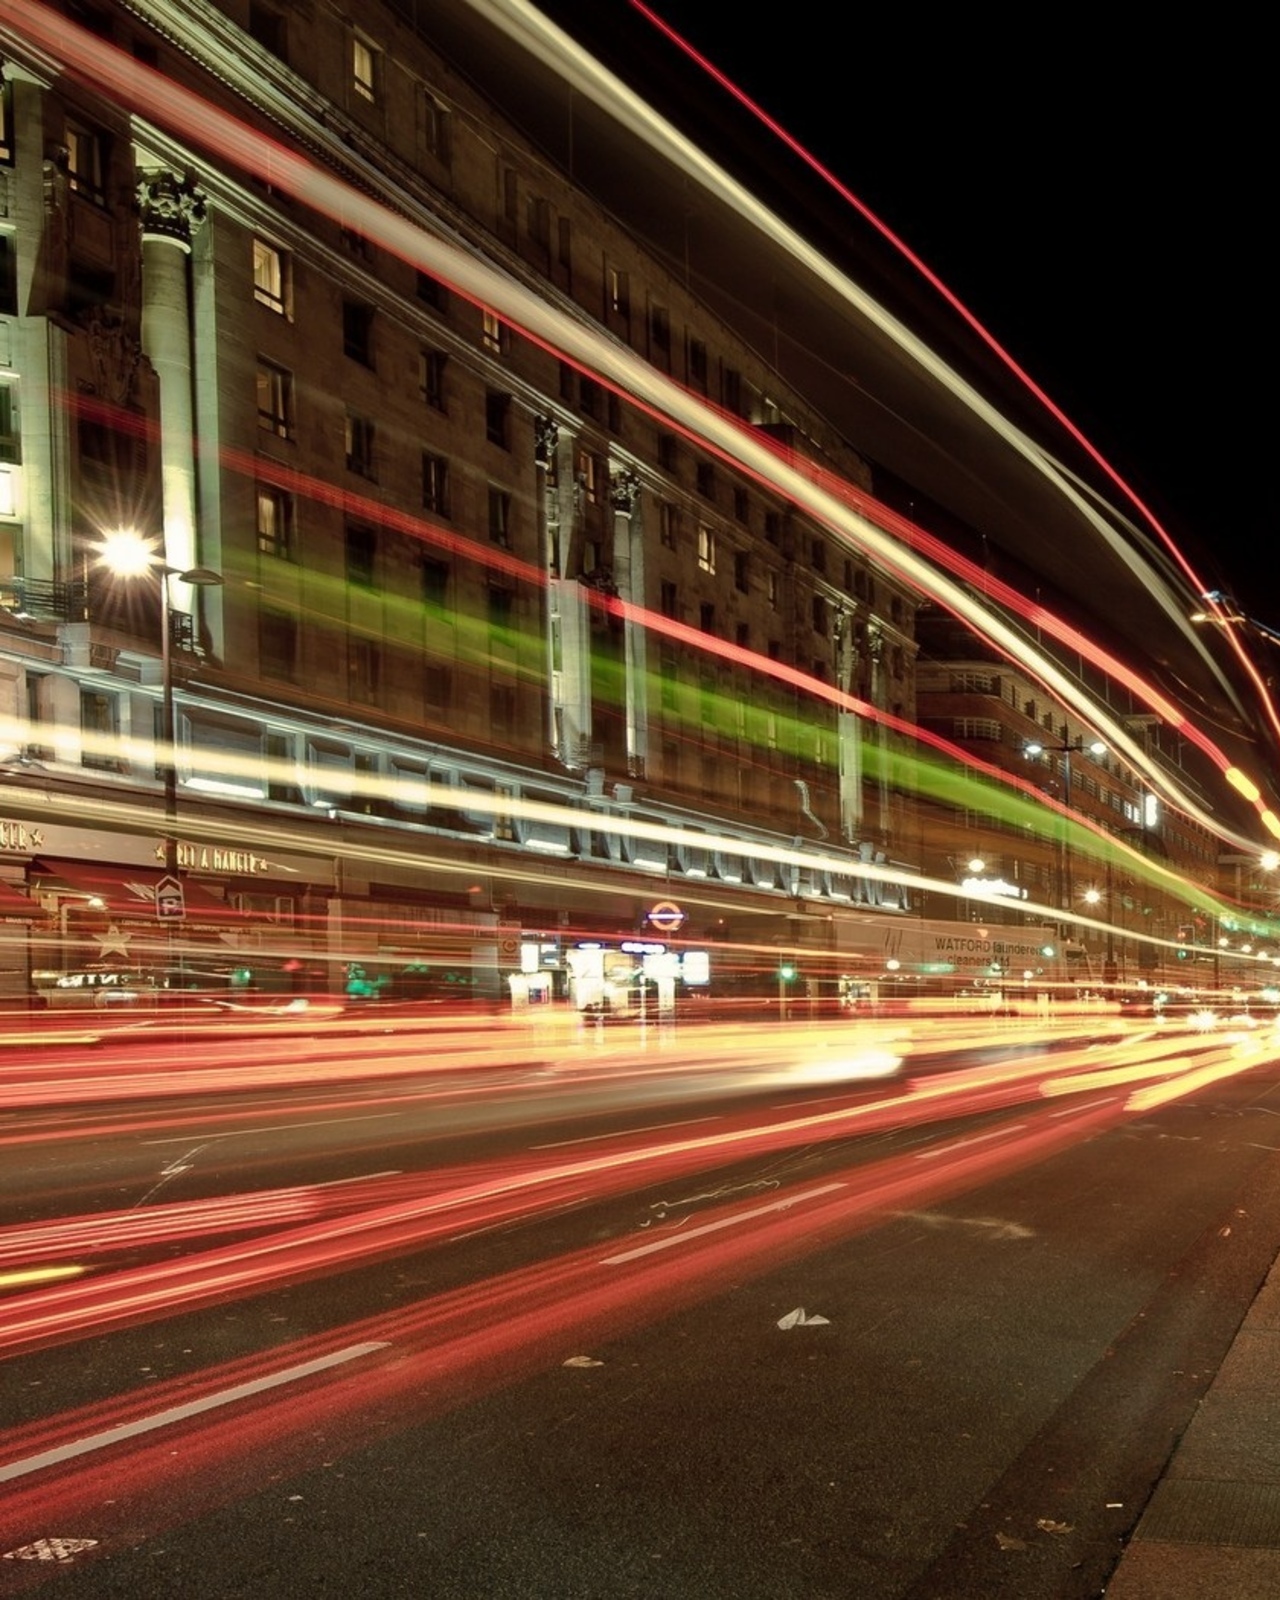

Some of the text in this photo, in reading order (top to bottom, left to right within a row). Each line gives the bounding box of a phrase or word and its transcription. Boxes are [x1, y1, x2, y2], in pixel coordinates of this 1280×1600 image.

[201, 848, 209, 868] A
[935, 937, 991, 953] WATFORD
[947, 954, 991, 967] cleaners
